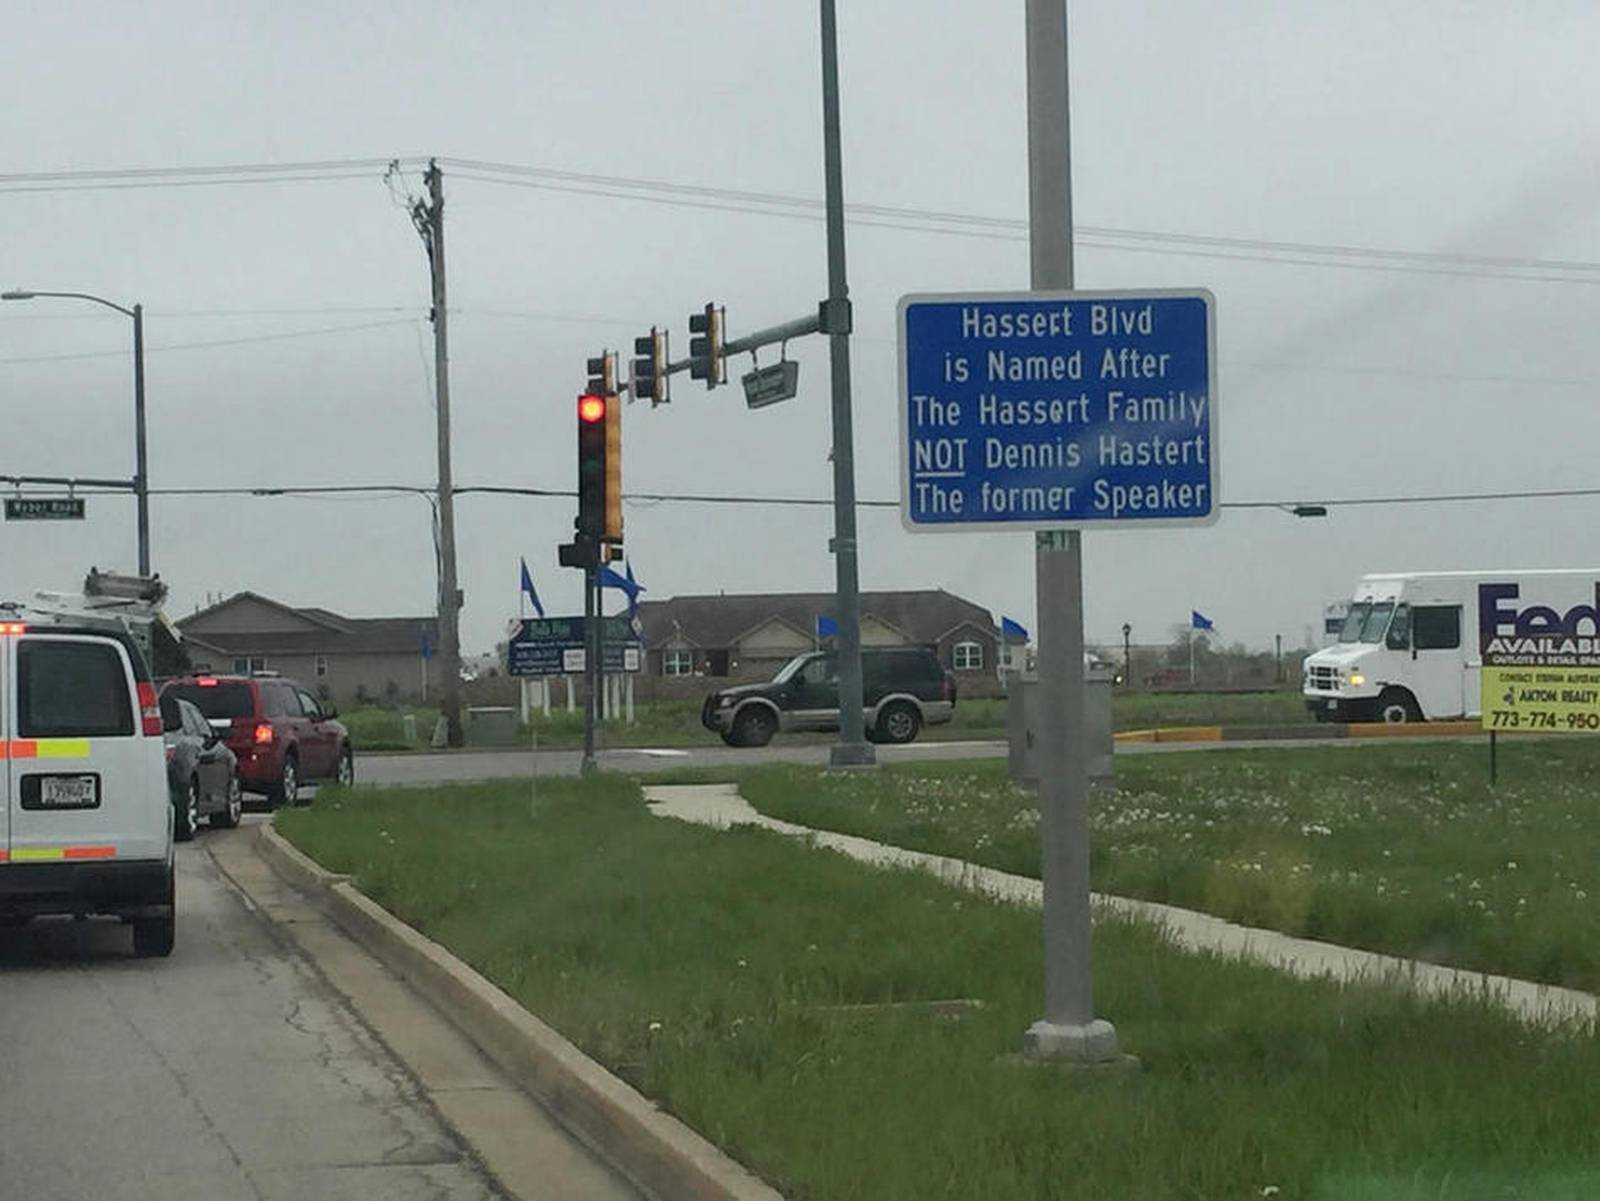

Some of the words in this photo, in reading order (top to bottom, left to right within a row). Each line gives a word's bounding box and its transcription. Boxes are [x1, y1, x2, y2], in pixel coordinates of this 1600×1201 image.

[963, 307, 1073, 338] Hassert
[1091, 305, 1153, 336] Blvd
[945, 352, 969, 382] is
[988, 350, 1082, 381] Named
[1100, 348, 1171, 379] After
[912, 396, 961, 426] The
[980, 393, 1089, 425] Hassert
[1108, 391, 1206, 428] Family
[915, 438, 968, 471] NOT
[986, 437, 1081, 469] Dennis
[1099, 435, 1206, 466] Hastert
[916, 483, 964, 514] The
[981, 482, 1075, 512] former
[1094, 479, 1206, 517] Speaker
[1562, 690, 1599, 704] REALTY
